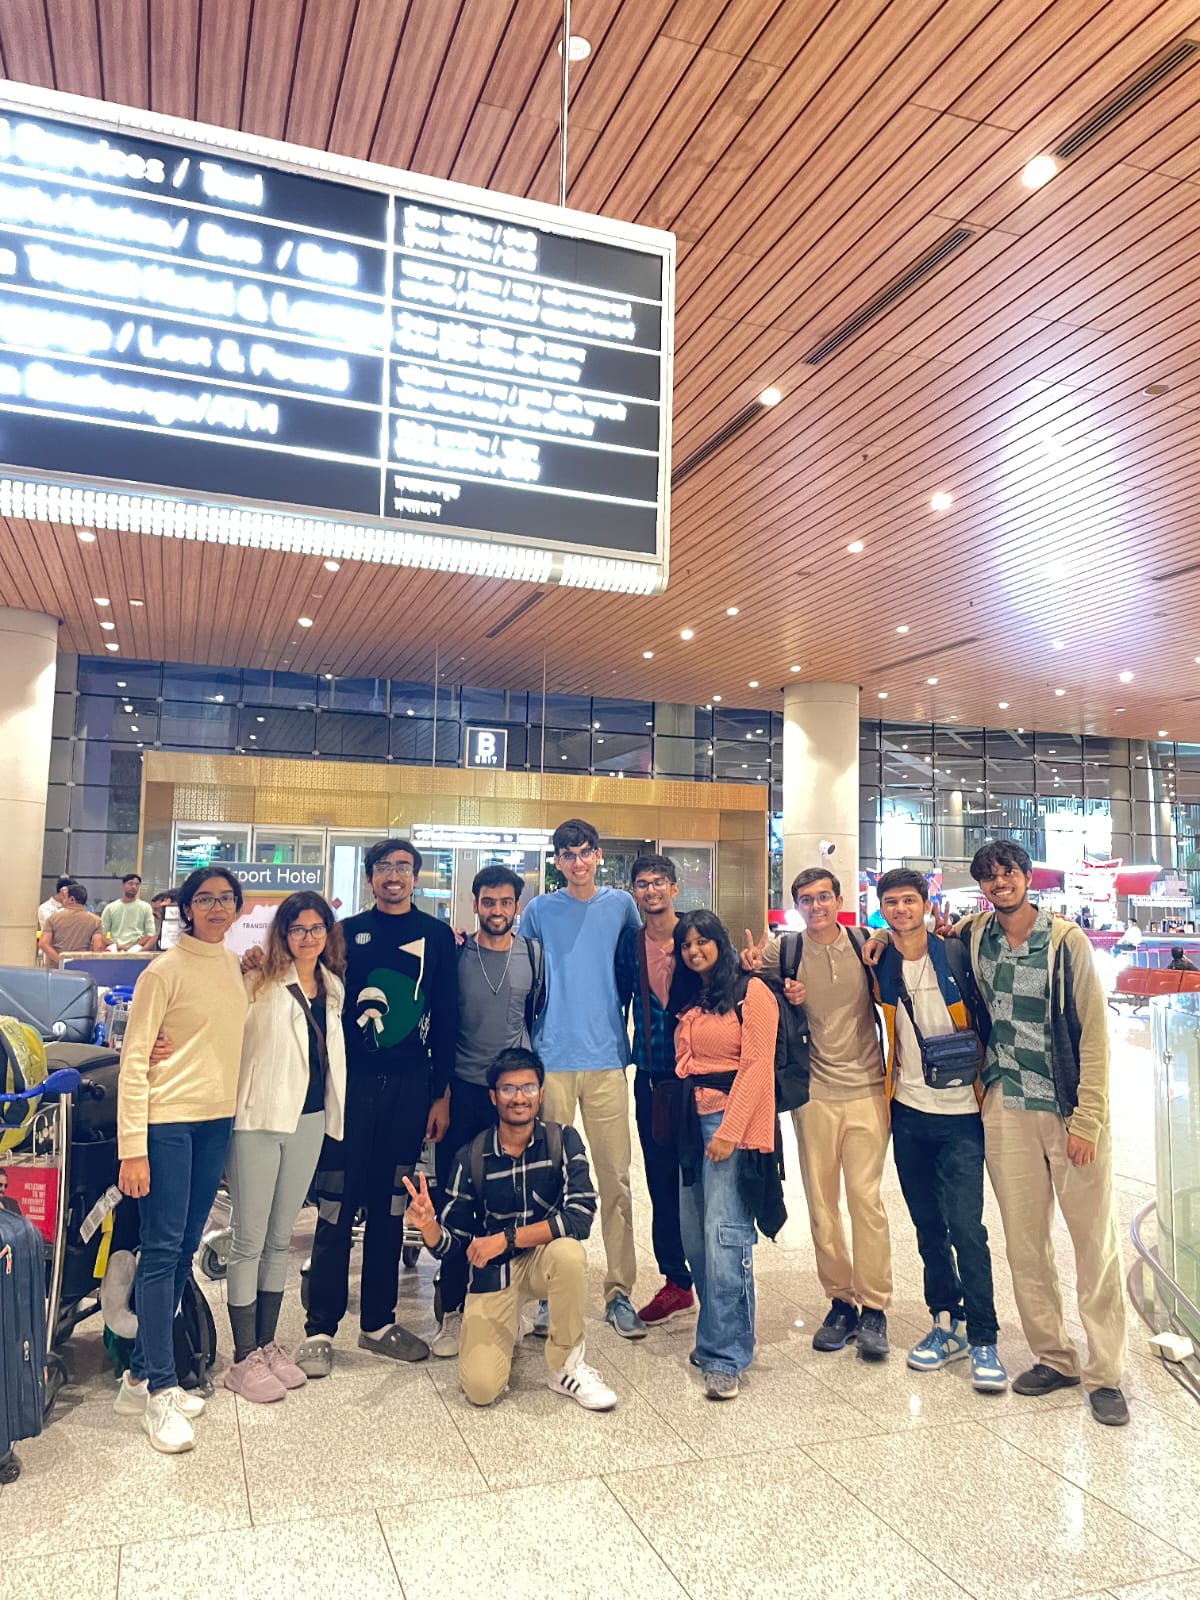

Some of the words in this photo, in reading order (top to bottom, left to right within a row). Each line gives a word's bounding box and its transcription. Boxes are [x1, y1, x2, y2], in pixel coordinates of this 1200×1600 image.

[478, 732, 496, 757] B
[227, 866, 272, 884] port
[277, 867, 321, 884] Hotel
